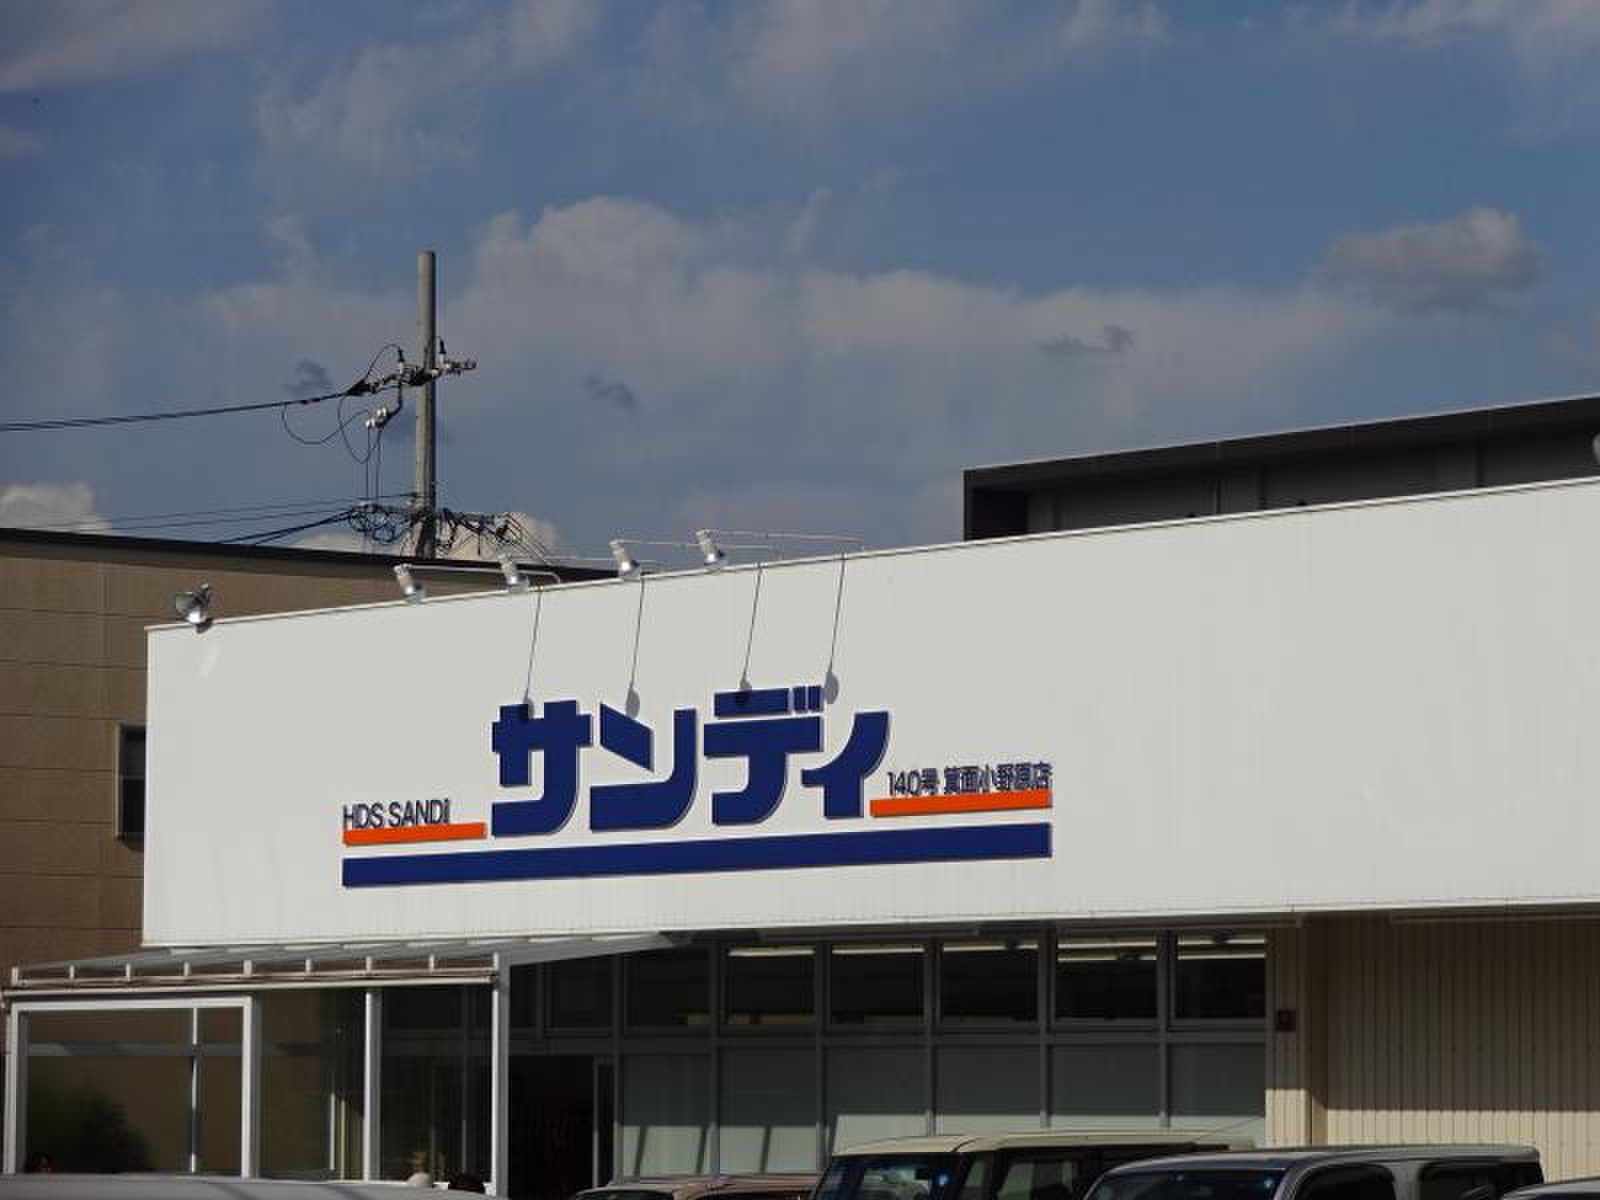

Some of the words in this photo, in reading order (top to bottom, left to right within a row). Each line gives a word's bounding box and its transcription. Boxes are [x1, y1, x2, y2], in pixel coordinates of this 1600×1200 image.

[492, 685, 890, 838] サンディ
[343, 803, 384, 831] HDS
[388, 798, 450, 827] SANDI
